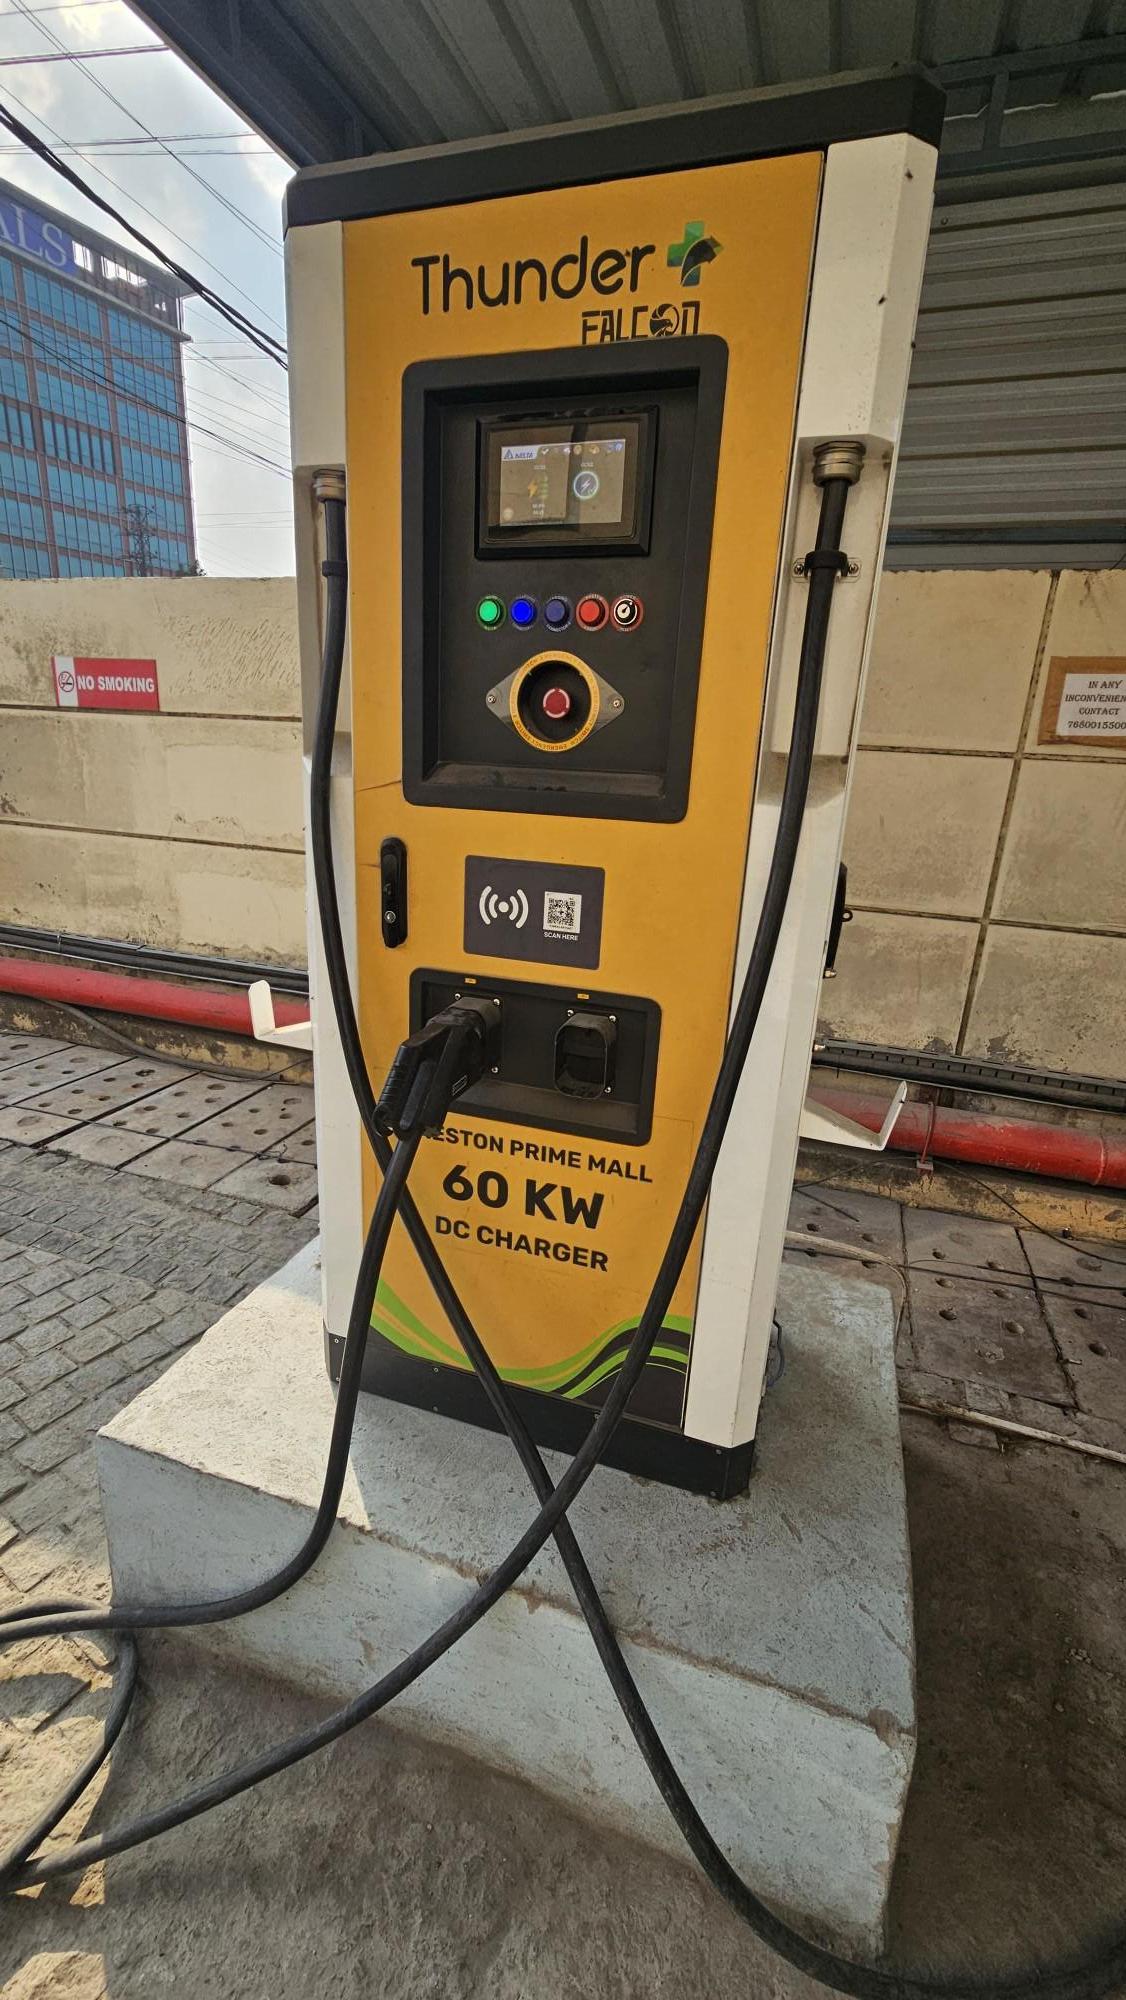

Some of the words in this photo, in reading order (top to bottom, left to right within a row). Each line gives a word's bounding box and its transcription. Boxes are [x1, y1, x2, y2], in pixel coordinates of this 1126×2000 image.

[411, 235, 657, 315] Thunder
[581, 300, 701, 345] FALCON
[76, 675, 95, 691] NO
[98, 676, 155, 693] SMOKING
[1088, 681, 1099, 689] IN
[1100, 680, 1123, 689] ANY
[1079, 707, 1120, 715] CONTACT
[543, 931, 561, 939] SCAN
[561, 933, 579, 941] HERE
[509, 1139, 582, 1169] PRIME
[588, 1154, 653, 1183] MALL
[442, 1164, 509, 1209] 60
[524, 1178, 605, 1230] KW
[435, 1215, 470, 1240] DC
[476, 1225, 609, 1273] CHARGER
